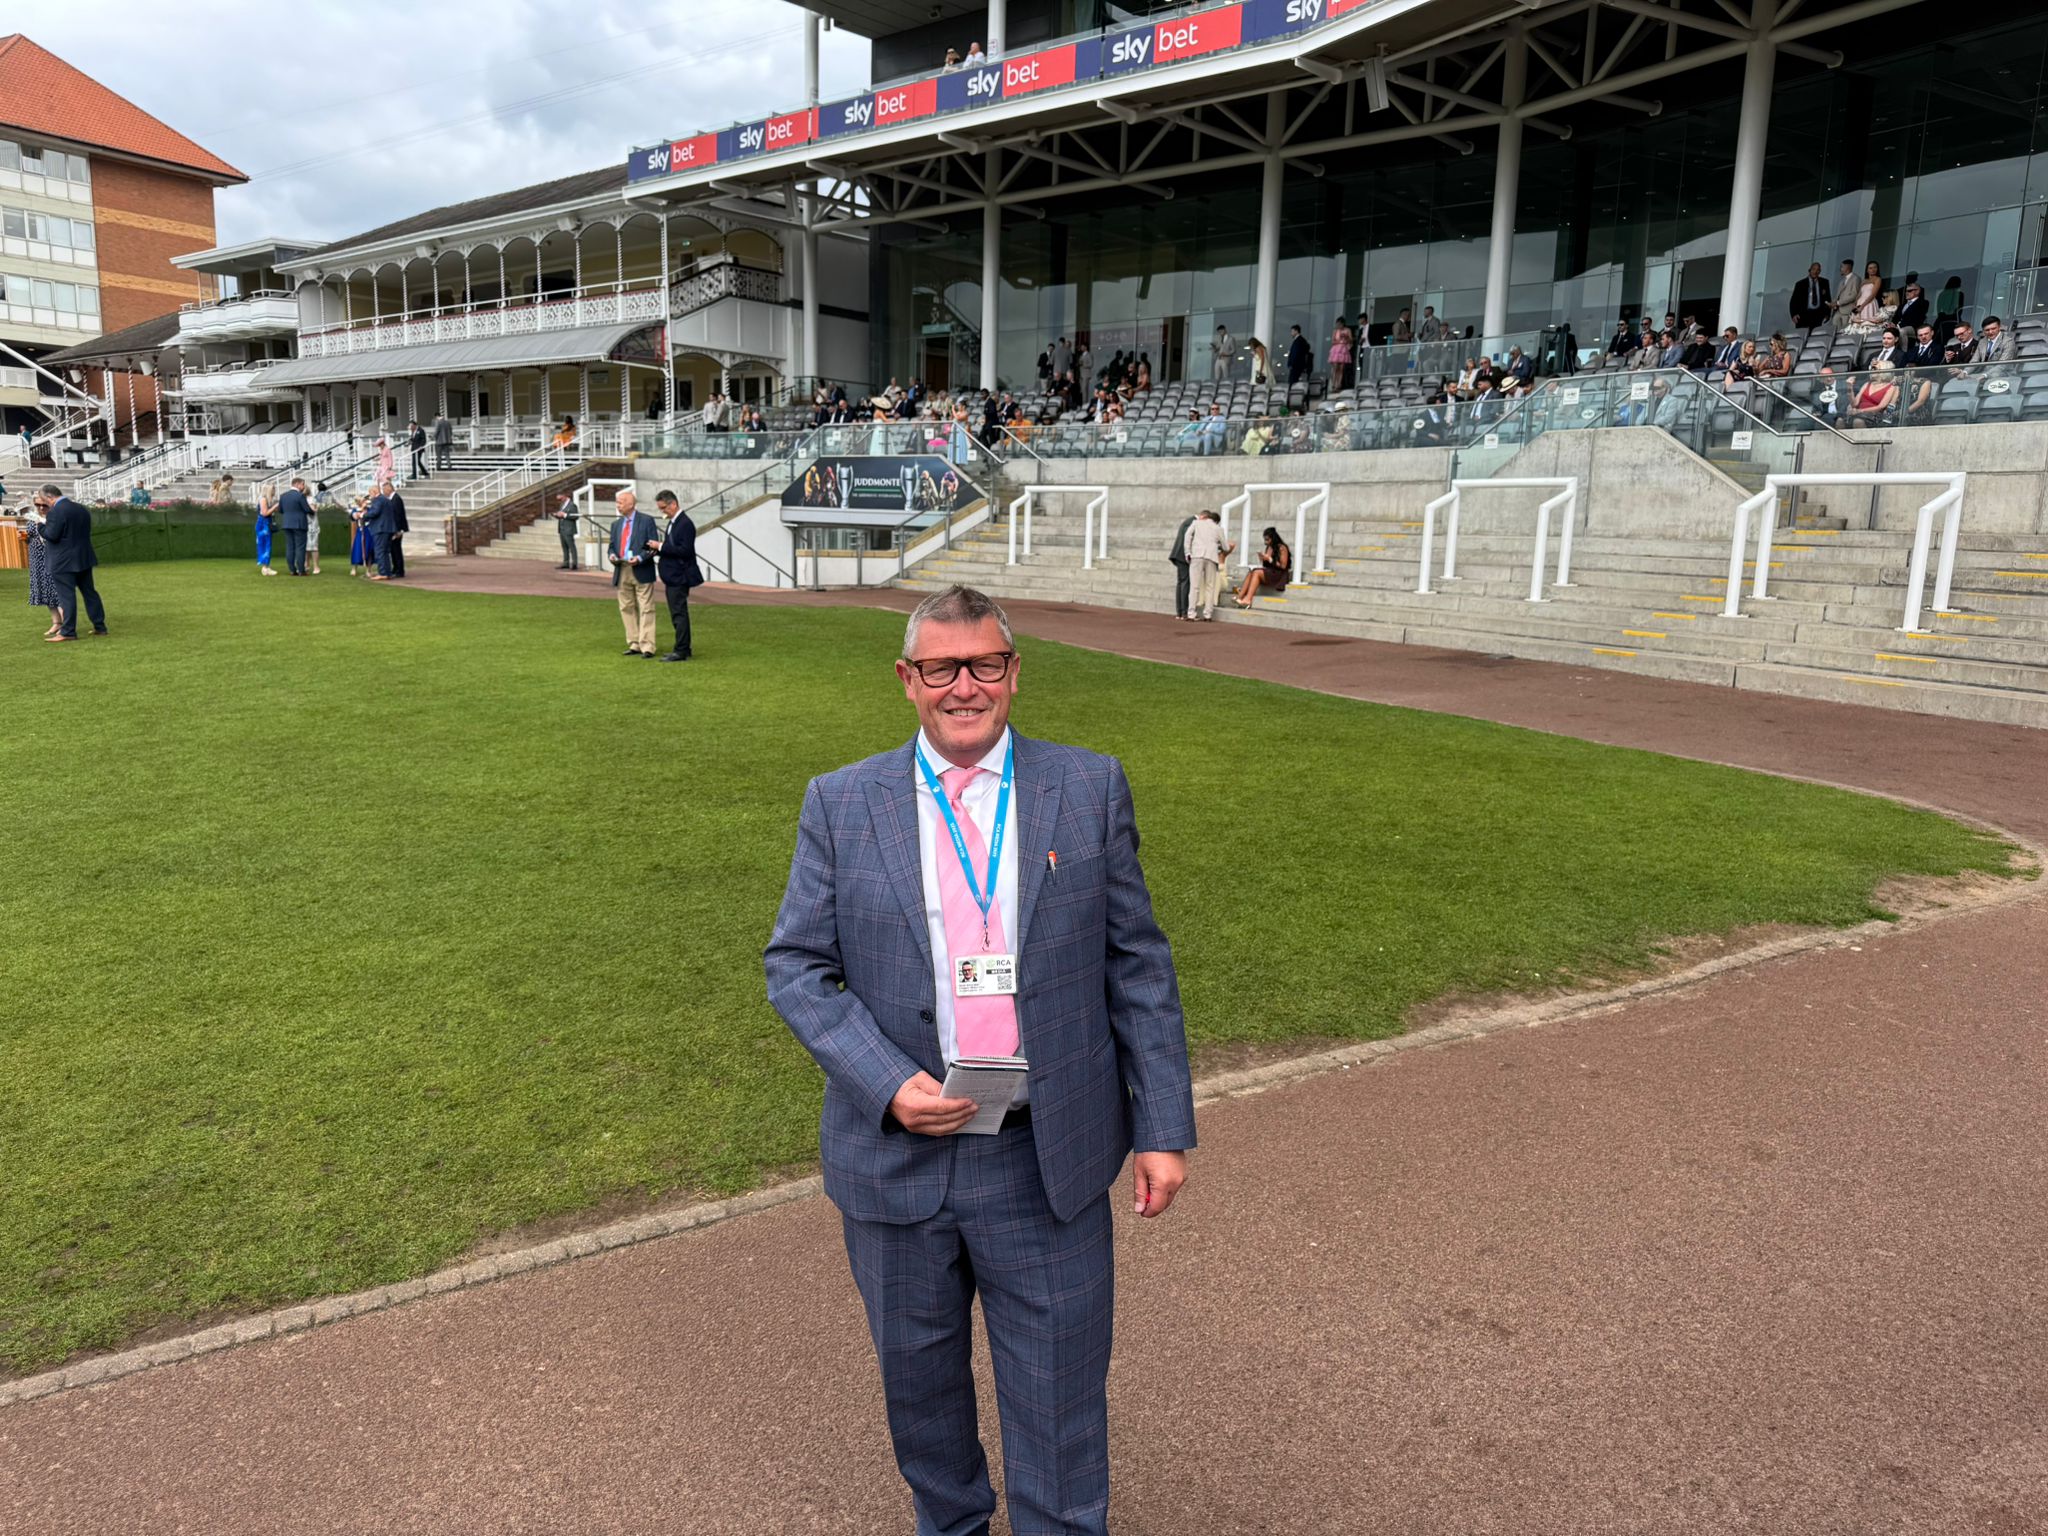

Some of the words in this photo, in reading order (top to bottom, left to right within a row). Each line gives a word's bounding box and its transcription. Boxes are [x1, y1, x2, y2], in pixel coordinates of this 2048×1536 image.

[1112, 34, 1151, 64] sky
[1157, 22, 1199, 52] bet
[967, 68, 1001, 97] sky
[1005, 59, 1041, 87] bet
[844, 99, 873, 126] sky
[877, 91, 907, 116] bet
[739, 125, 764, 150] sky
[768, 119, 794, 141] bet
[647, 149, 670, 172] sky
[672, 143, 696, 163] bet
[854, 477, 900, 487] JUDDMONTE
